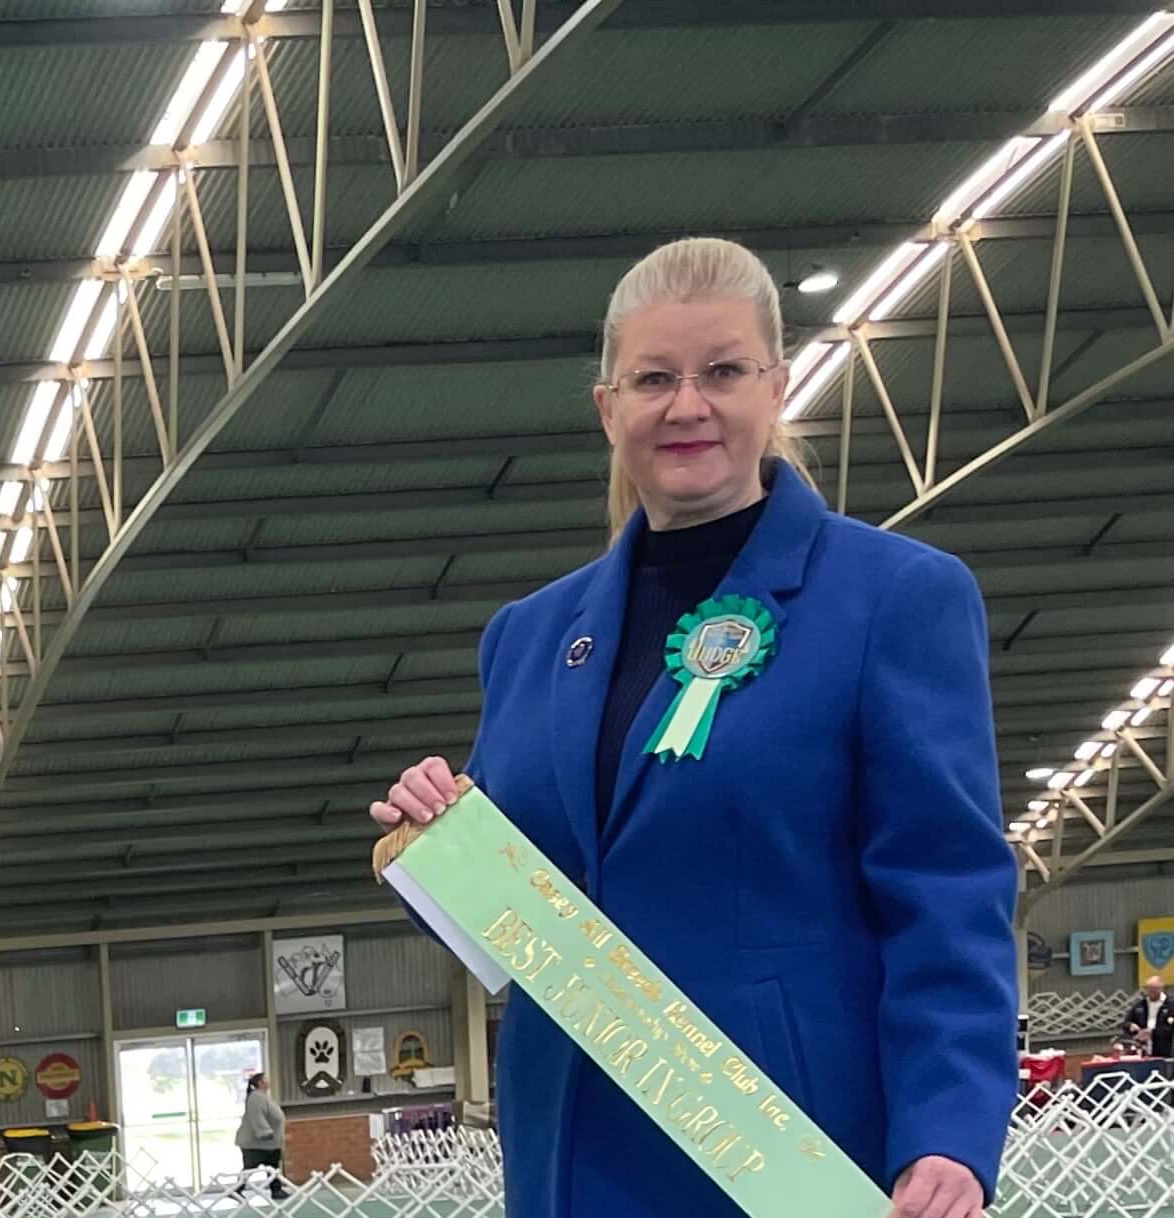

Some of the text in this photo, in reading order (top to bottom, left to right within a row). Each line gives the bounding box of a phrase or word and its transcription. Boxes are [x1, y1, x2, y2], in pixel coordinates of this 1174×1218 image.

[482, 905, 563, 983] BEST
[544, 974, 648, 1074] JUNIOR
[636, 1056, 685, 1105] IN
[666, 1091, 765, 1182] GROUP
[530, 869, 579, 920] Casey
[580, 920, 613, 949] All
[662, 1000, 723, 1058] Kennel
[722, 1054, 759, 1096] Club
[758, 1095, 790, 1132] Inc.
